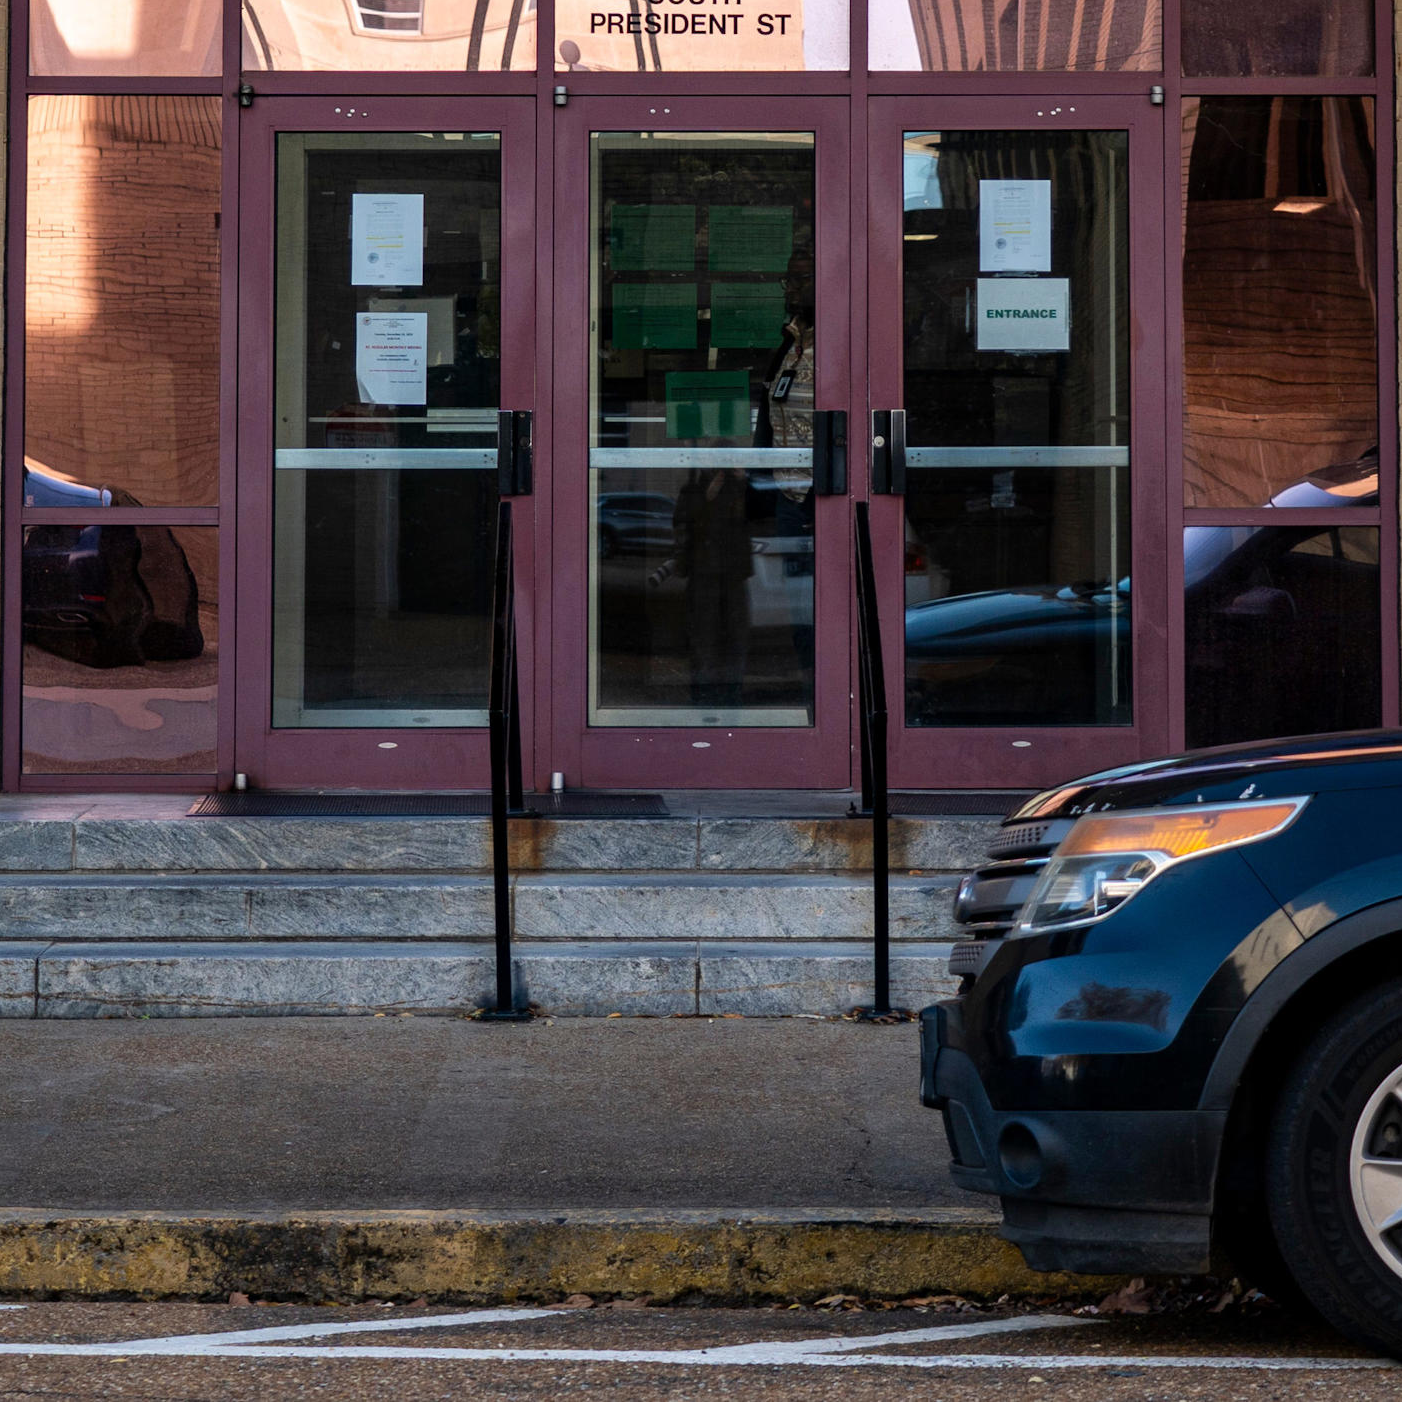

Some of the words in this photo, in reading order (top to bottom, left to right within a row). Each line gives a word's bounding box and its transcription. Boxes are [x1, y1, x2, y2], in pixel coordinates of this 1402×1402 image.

[590, 12, 744, 36] PRESIDENT
[756, 13, 792, 36] ST
[986, 309, 1058, 319] ENTRANCE
